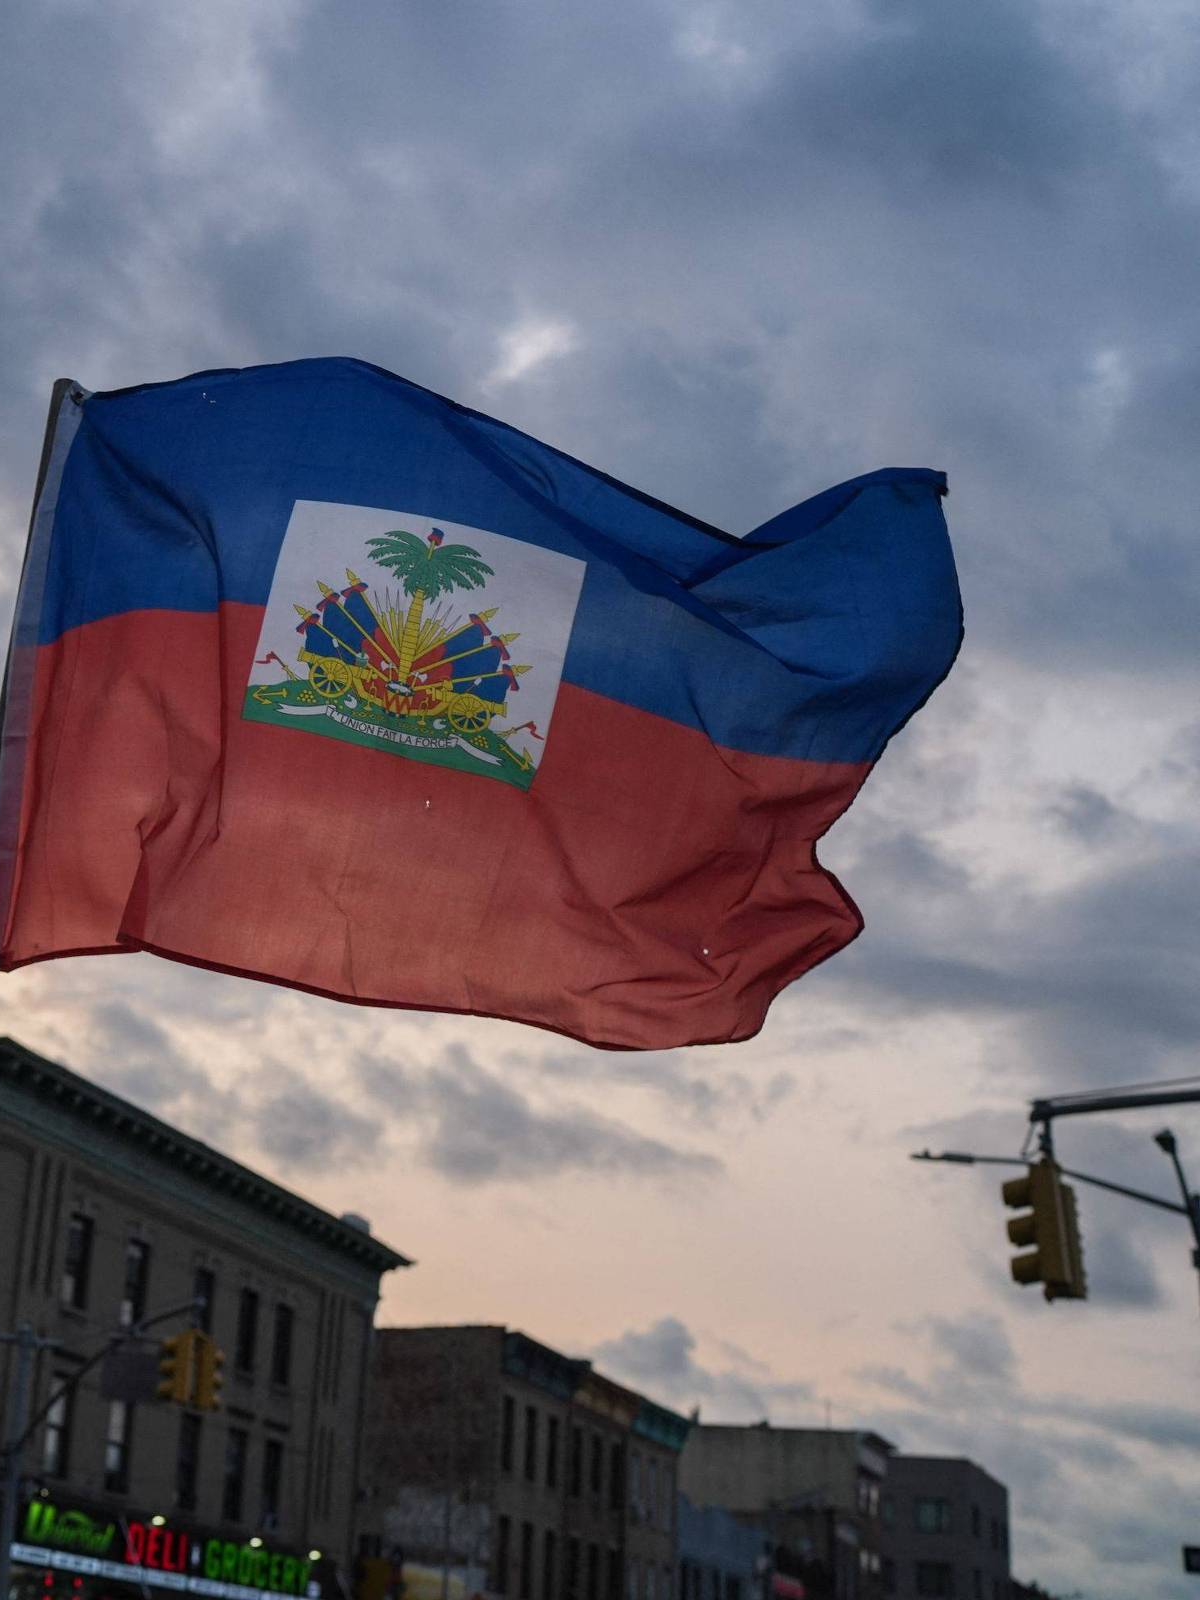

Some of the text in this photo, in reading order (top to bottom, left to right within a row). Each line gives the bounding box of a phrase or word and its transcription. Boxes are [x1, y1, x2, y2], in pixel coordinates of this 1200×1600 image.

[377, 727, 397, 741] FAIT
[399, 734, 412, 745] LA
[415, 737, 452, 748] FORCE
[124, 1519, 189, 1567] DELI
[204, 1538, 312, 1596] GROCERY
